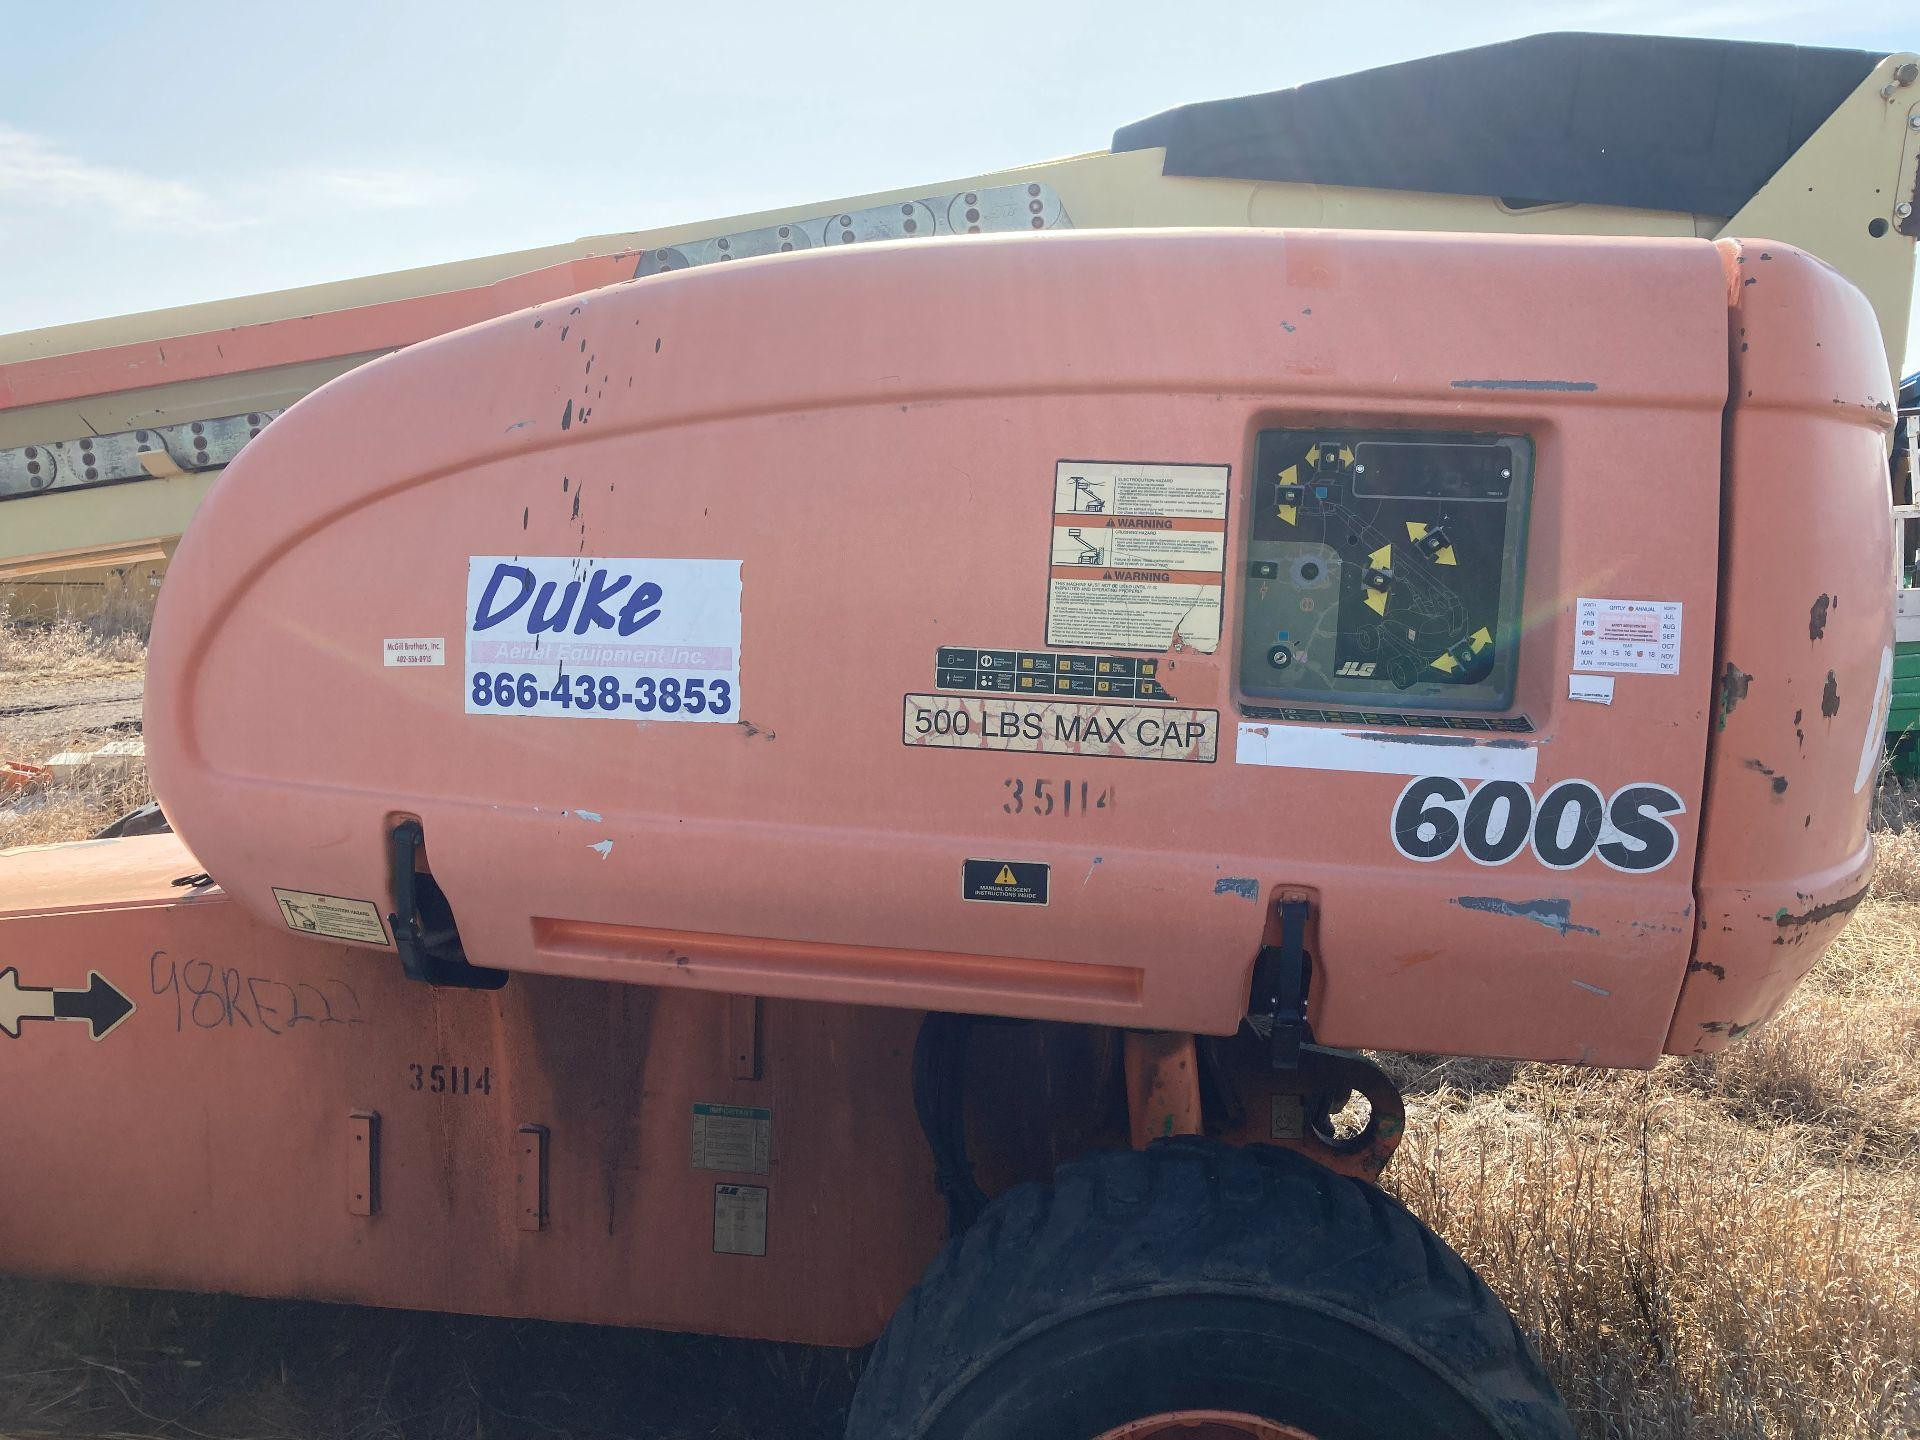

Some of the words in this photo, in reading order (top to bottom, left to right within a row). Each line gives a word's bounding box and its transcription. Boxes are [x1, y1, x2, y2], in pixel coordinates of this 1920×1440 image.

[1118, 518, 1173, 529] WARNING
[1114, 571, 1170, 582] WARNING
[472, 563, 663, 636] Duke
[387, 642, 403, 651] McGill
[495, 642, 552, 661] Aerial
[559, 645, 666, 668] Equipment
[669, 648, 707, 665] Inc.
[1336, 661, 1377, 677] JLG
[471, 671, 732, 715] 866-438-3853
[915, 709, 970, 736] 500
[981, 710, 1043, 740] LBS
[1055, 715, 1126, 745] MAX
[1136, 719, 1206, 748] CAP
[1391, 775, 1687, 874] 600S
[975, 890, 1016, 898] INSTRUCTIONS
[408, 1063, 492, 1095] 35114
[708, 1105, 755, 1117] IMPORTANT
